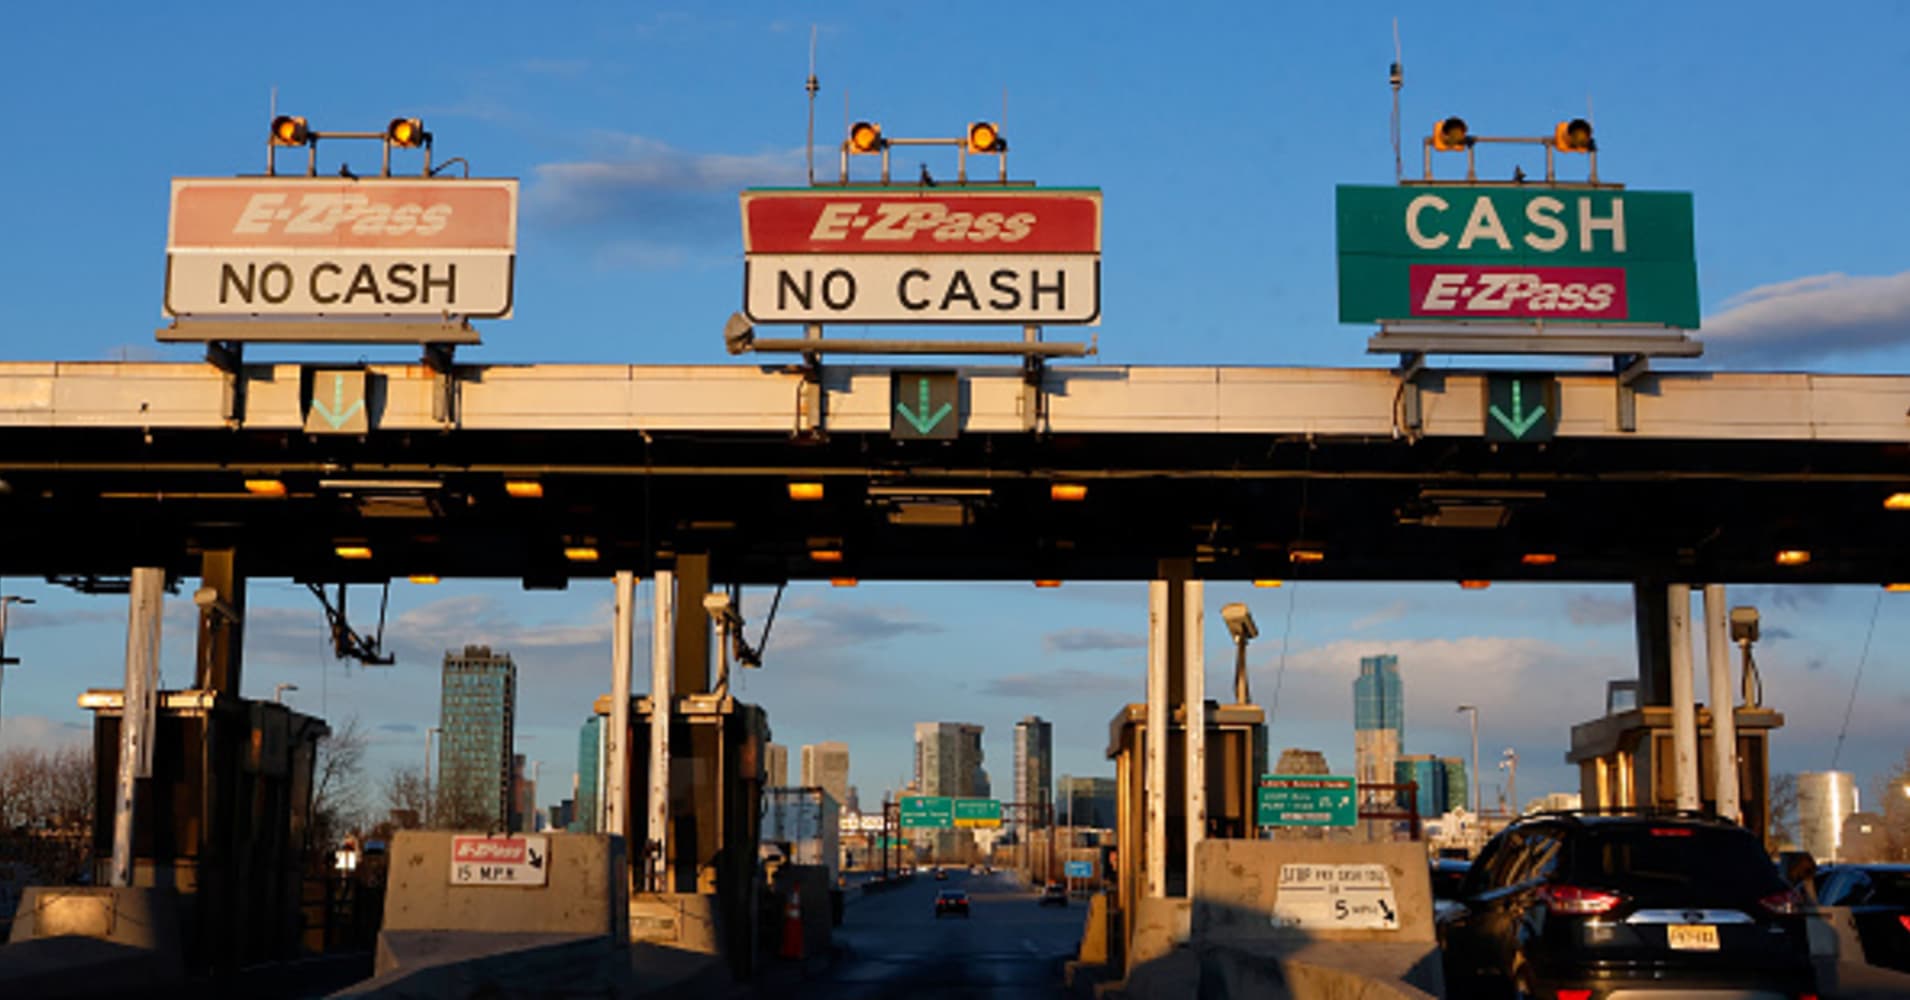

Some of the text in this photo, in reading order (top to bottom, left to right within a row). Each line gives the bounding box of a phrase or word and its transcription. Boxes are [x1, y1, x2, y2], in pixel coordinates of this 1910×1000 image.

[232, 192, 453, 236] E-ZPass
[809, 202, 1036, 243] E-ZPass
[1405, 194, 1627, 252] CASH
[218, 262, 456, 305] NO CASH
[776, 268, 1066, 312] NO CASH
[1421, 273, 1615, 311] E-ZPass
[1335, 899, 1349, 920] 5
